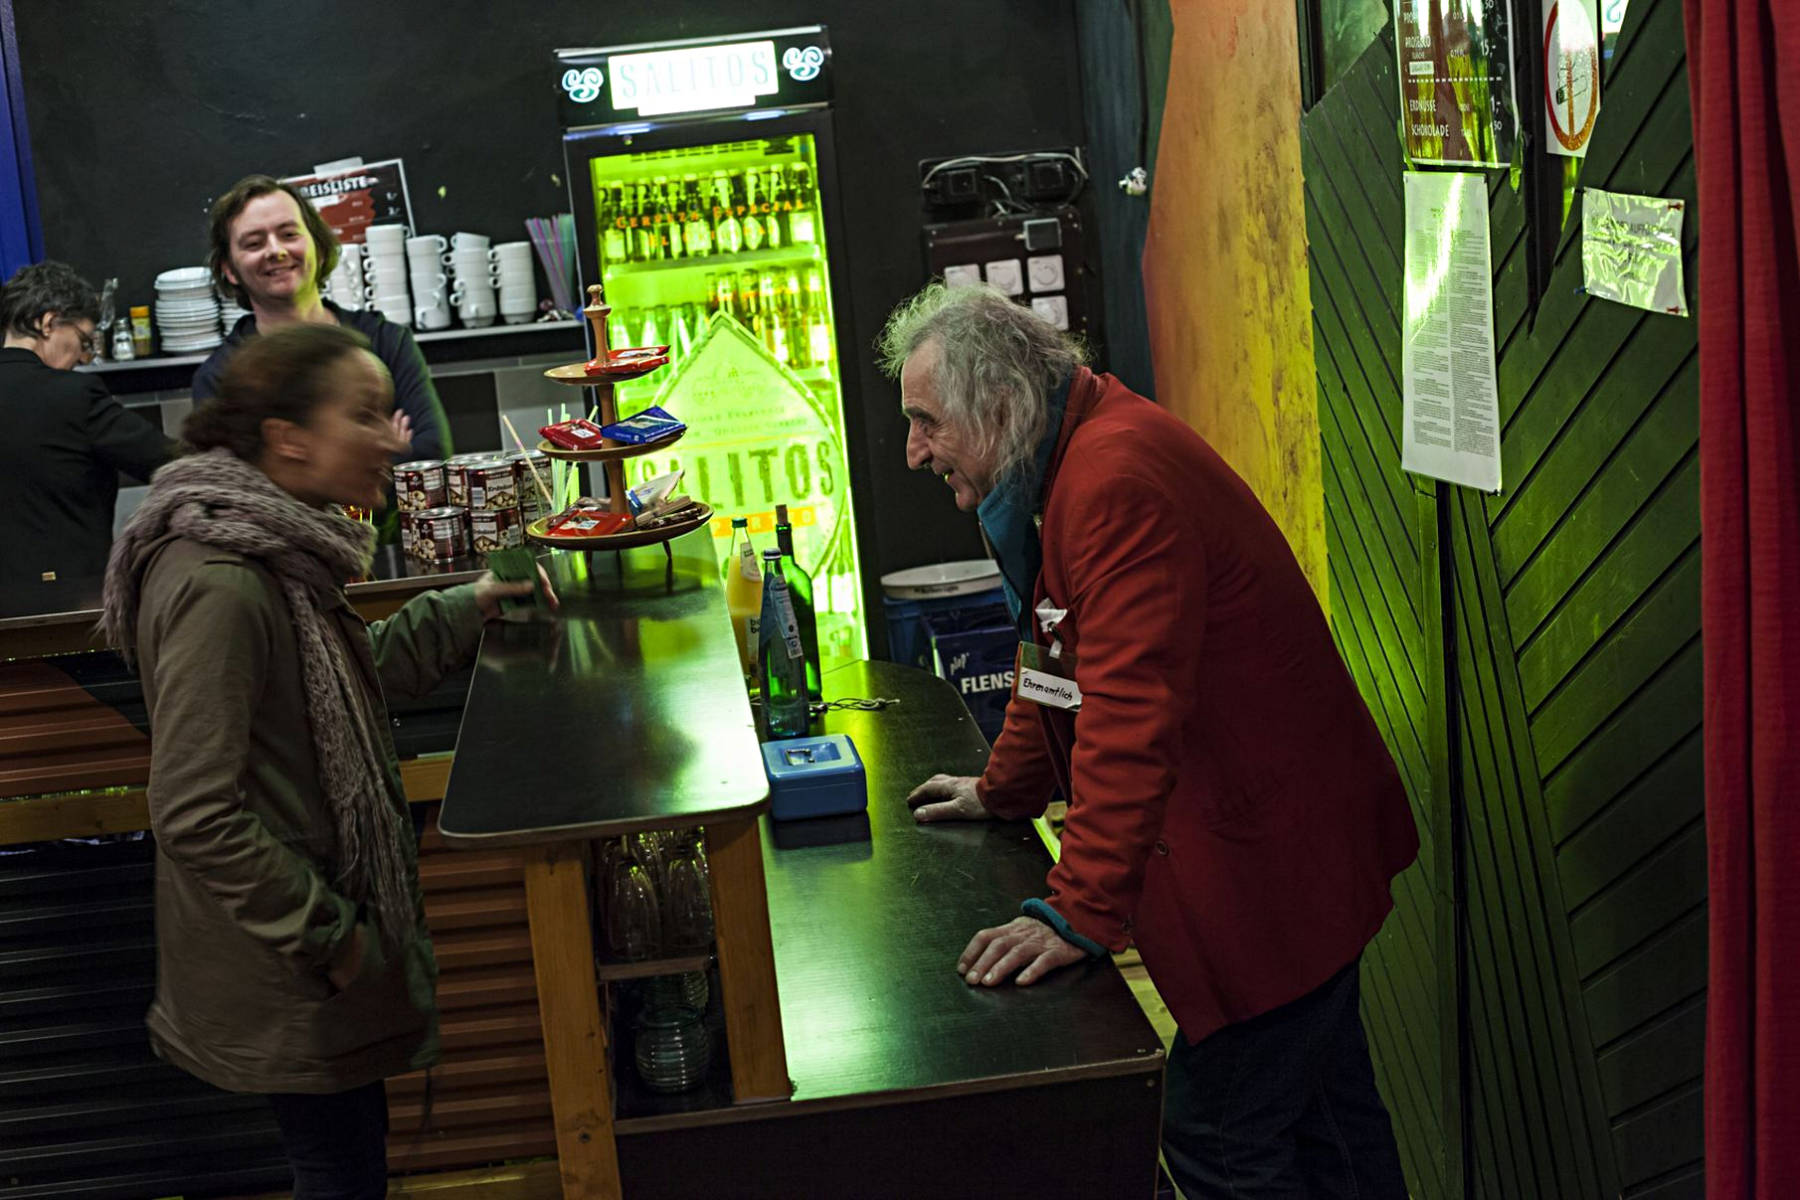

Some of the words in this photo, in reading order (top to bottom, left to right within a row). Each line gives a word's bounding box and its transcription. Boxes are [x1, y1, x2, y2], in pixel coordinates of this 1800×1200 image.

[619, 51, 769, 98] SALITOS
[1412, 123, 1449, 137] SCHOKOLADE
[300, 176, 368, 197] REISLISTE
[960, 670, 1015, 695] FLENS
[1023, 677, 1073, 701] Ehrenamtlich
